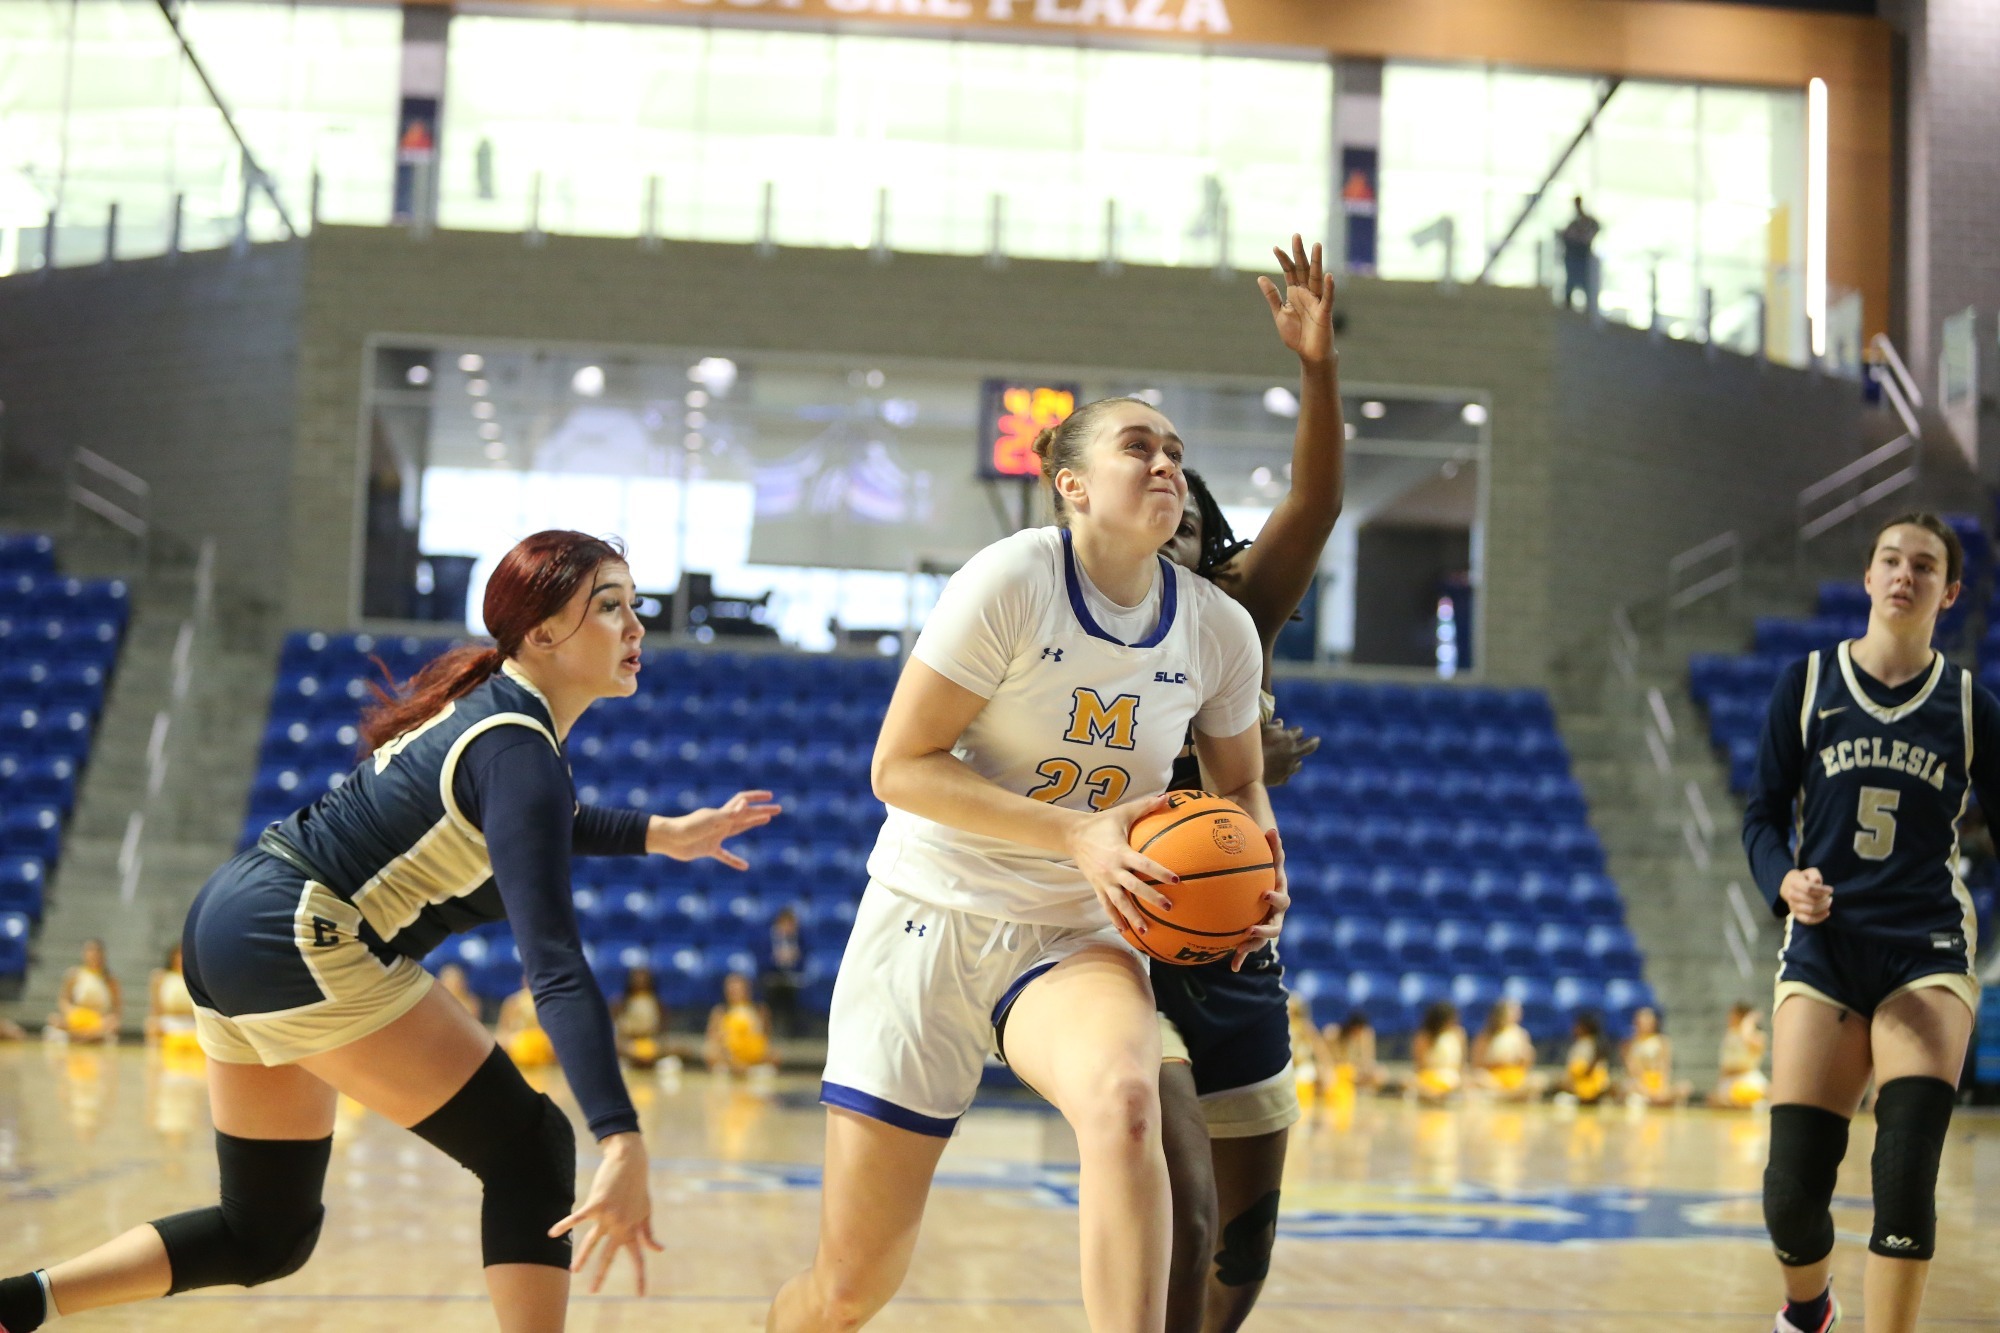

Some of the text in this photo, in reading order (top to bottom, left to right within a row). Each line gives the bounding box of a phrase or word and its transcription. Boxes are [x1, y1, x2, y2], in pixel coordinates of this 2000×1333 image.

[1153, 671, 1188, 684] SLC
[1063, 687, 1140, 750] M
[1819, 737, 1948, 791] ECCLESIA
[1853, 785, 1901, 861] 5
